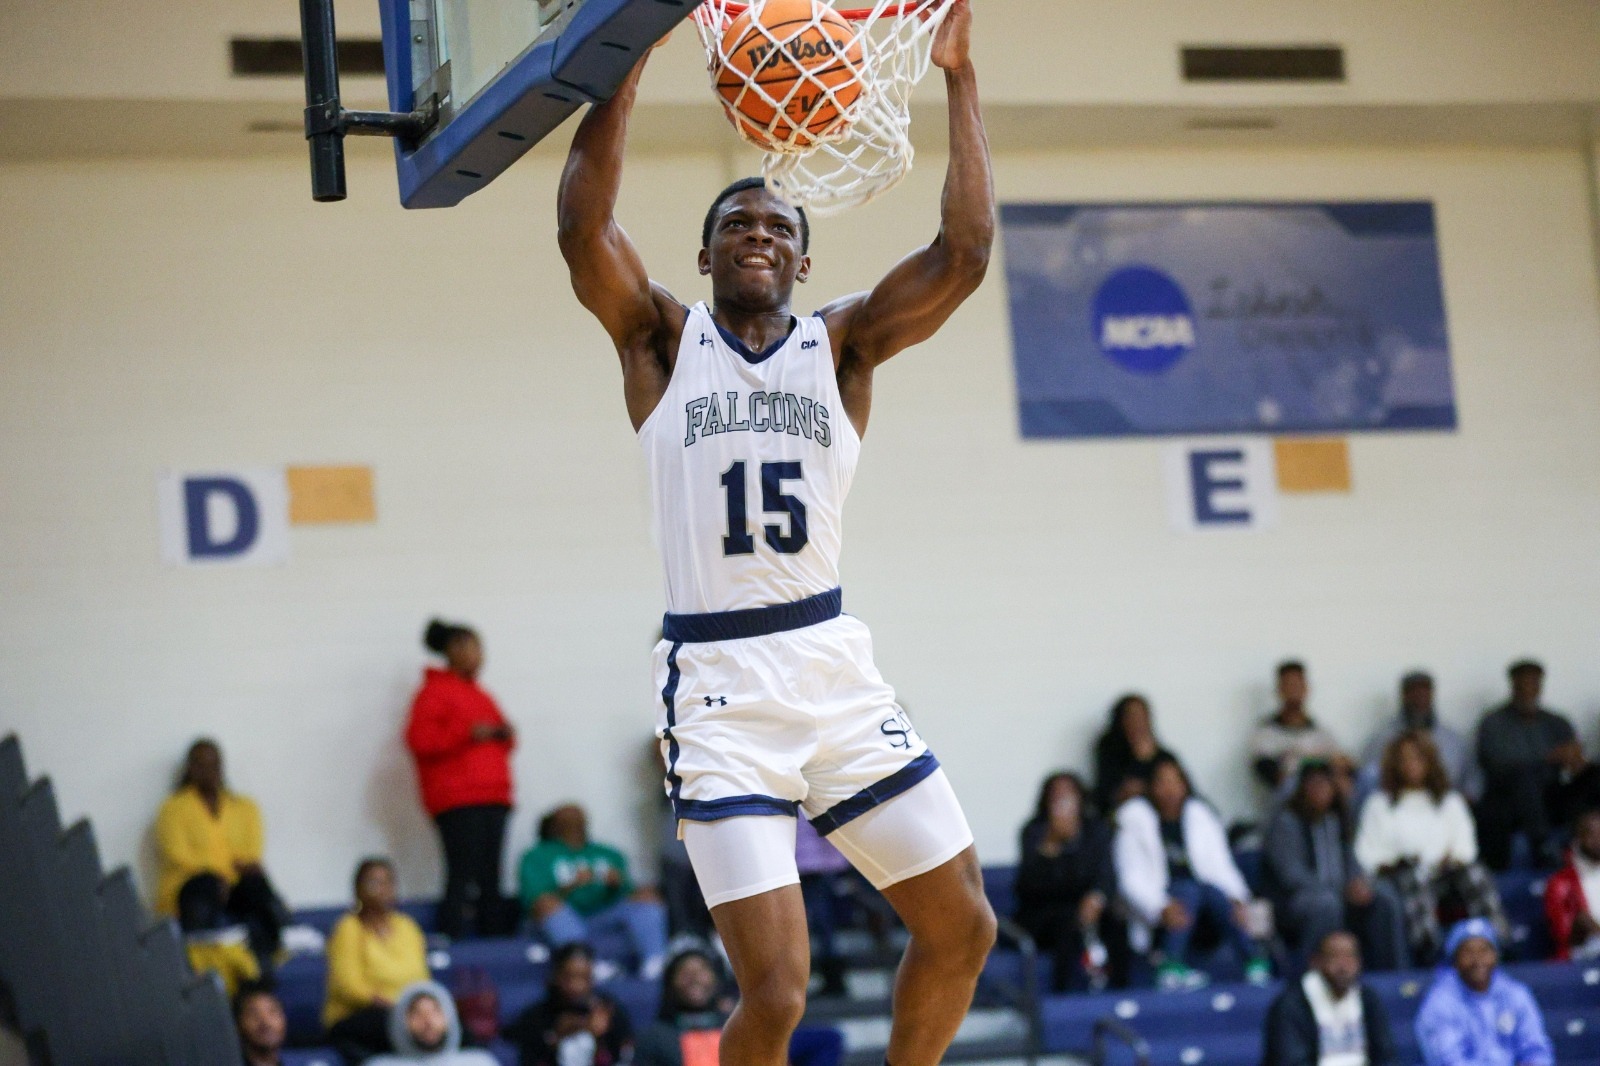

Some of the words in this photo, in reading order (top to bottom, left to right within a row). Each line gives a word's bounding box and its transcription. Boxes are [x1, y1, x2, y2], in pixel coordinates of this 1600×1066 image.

[1102, 314, 1196, 348] NCAA
[685, 391, 832, 448] FALCONS
[182, 475, 262, 560] D
[719, 458, 810, 559] 15
[1188, 448, 1253, 527] E
